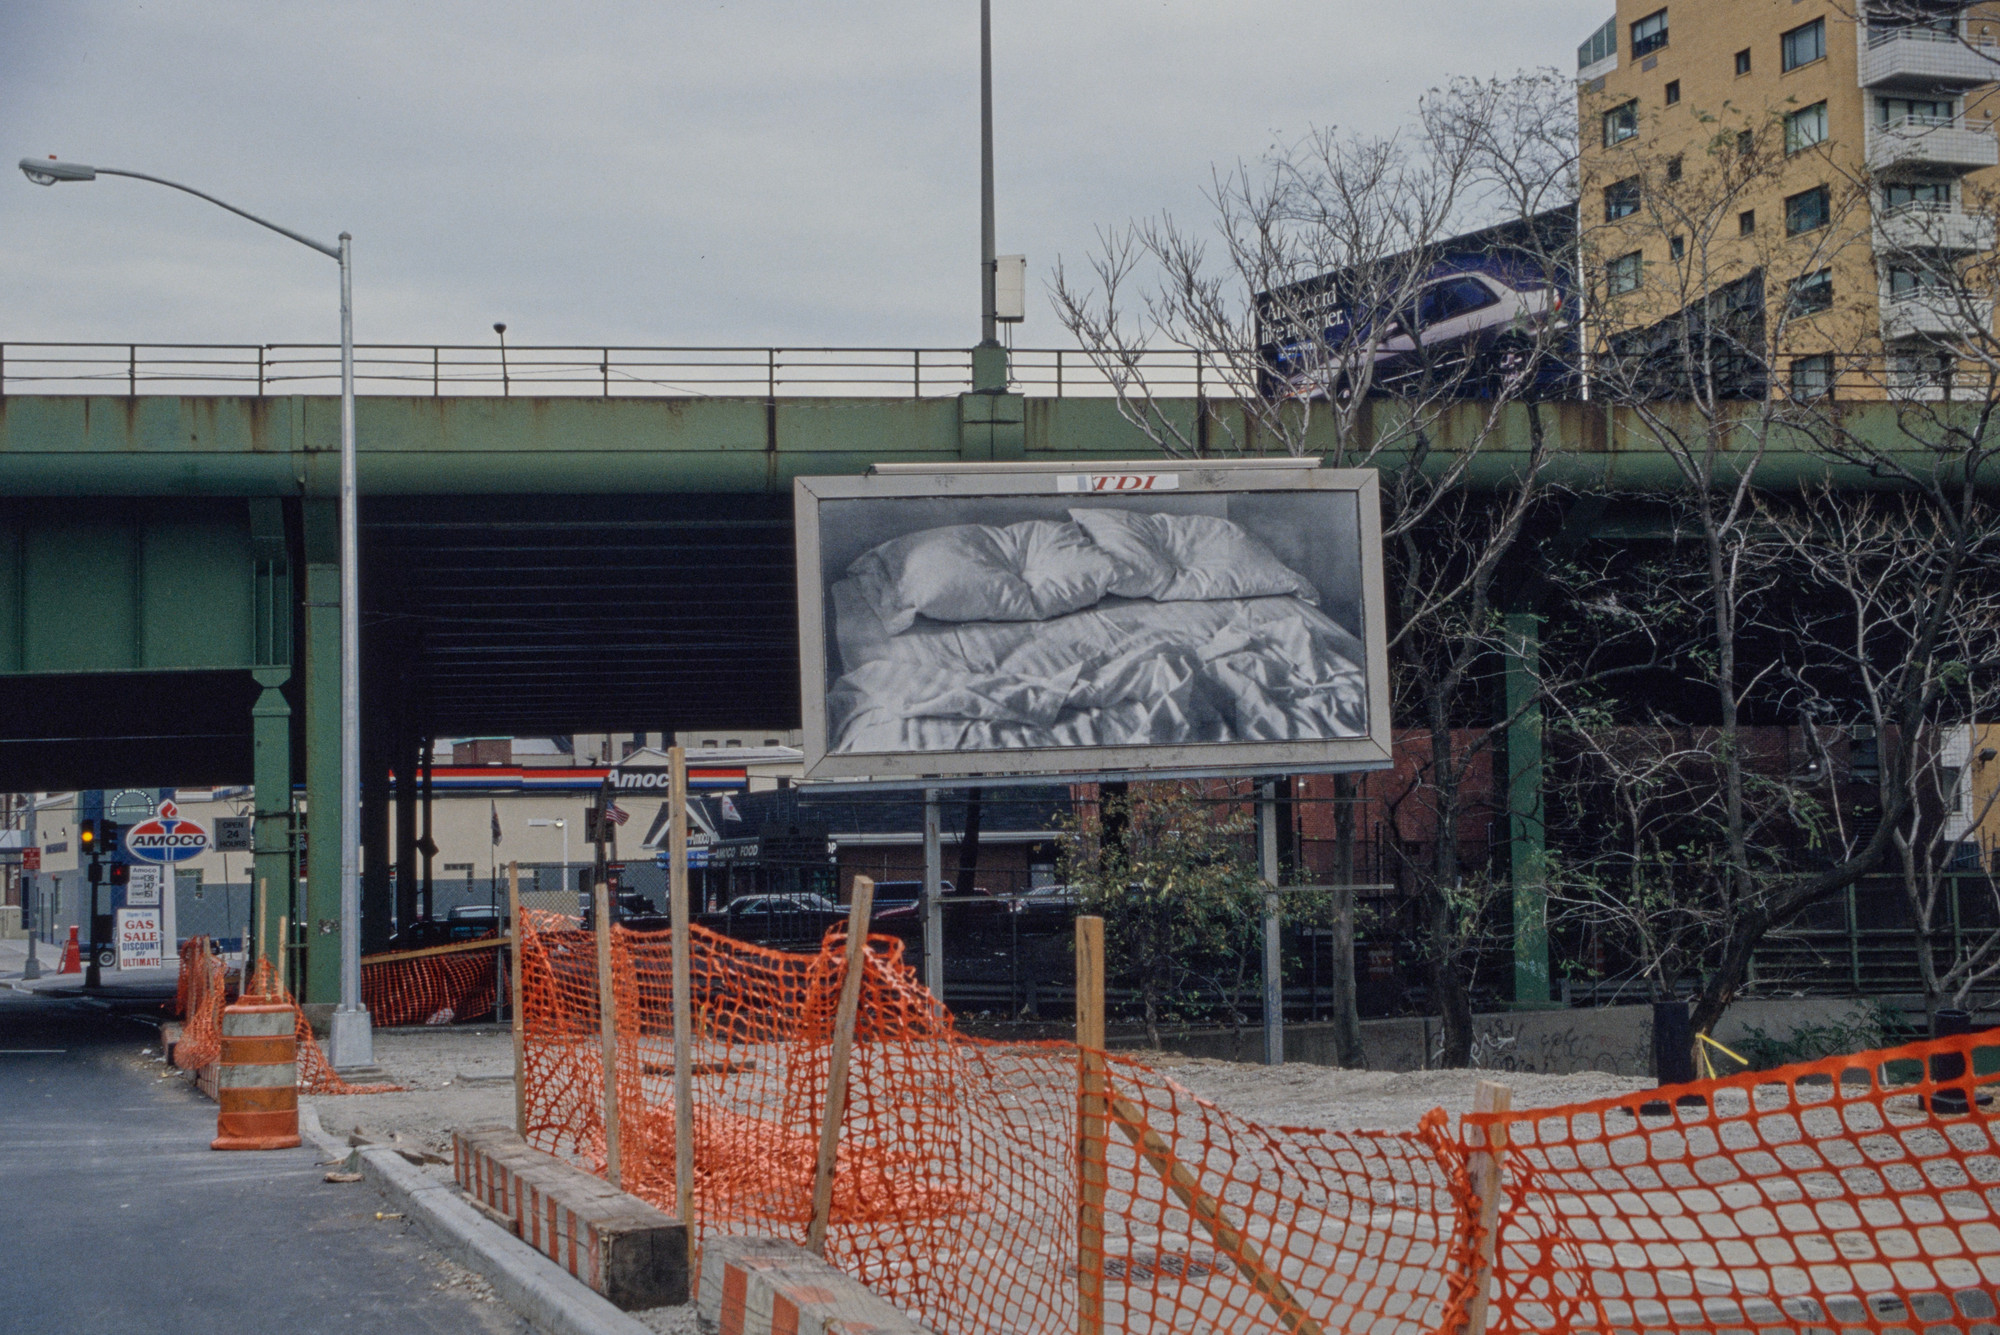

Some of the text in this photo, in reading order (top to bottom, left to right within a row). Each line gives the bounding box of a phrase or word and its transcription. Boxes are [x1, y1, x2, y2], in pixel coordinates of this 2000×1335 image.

[1289, 282, 1337, 315] ccord
[1093, 475, 1158, 491] TDI
[607, 769, 670, 788] Amoc
[222, 821, 244, 829] OPEN
[226, 830, 239, 839] 24
[132, 835, 207, 847] AMOCO
[220, 840, 247, 848] HOURS
[739, 844, 759, 857] FOOD
[125, 919, 155, 930] GAS
[123, 931, 158, 942] SALE
[122, 942, 159, 951] DISCOUNT
[122, 957, 160, 967] ULTIMATE
